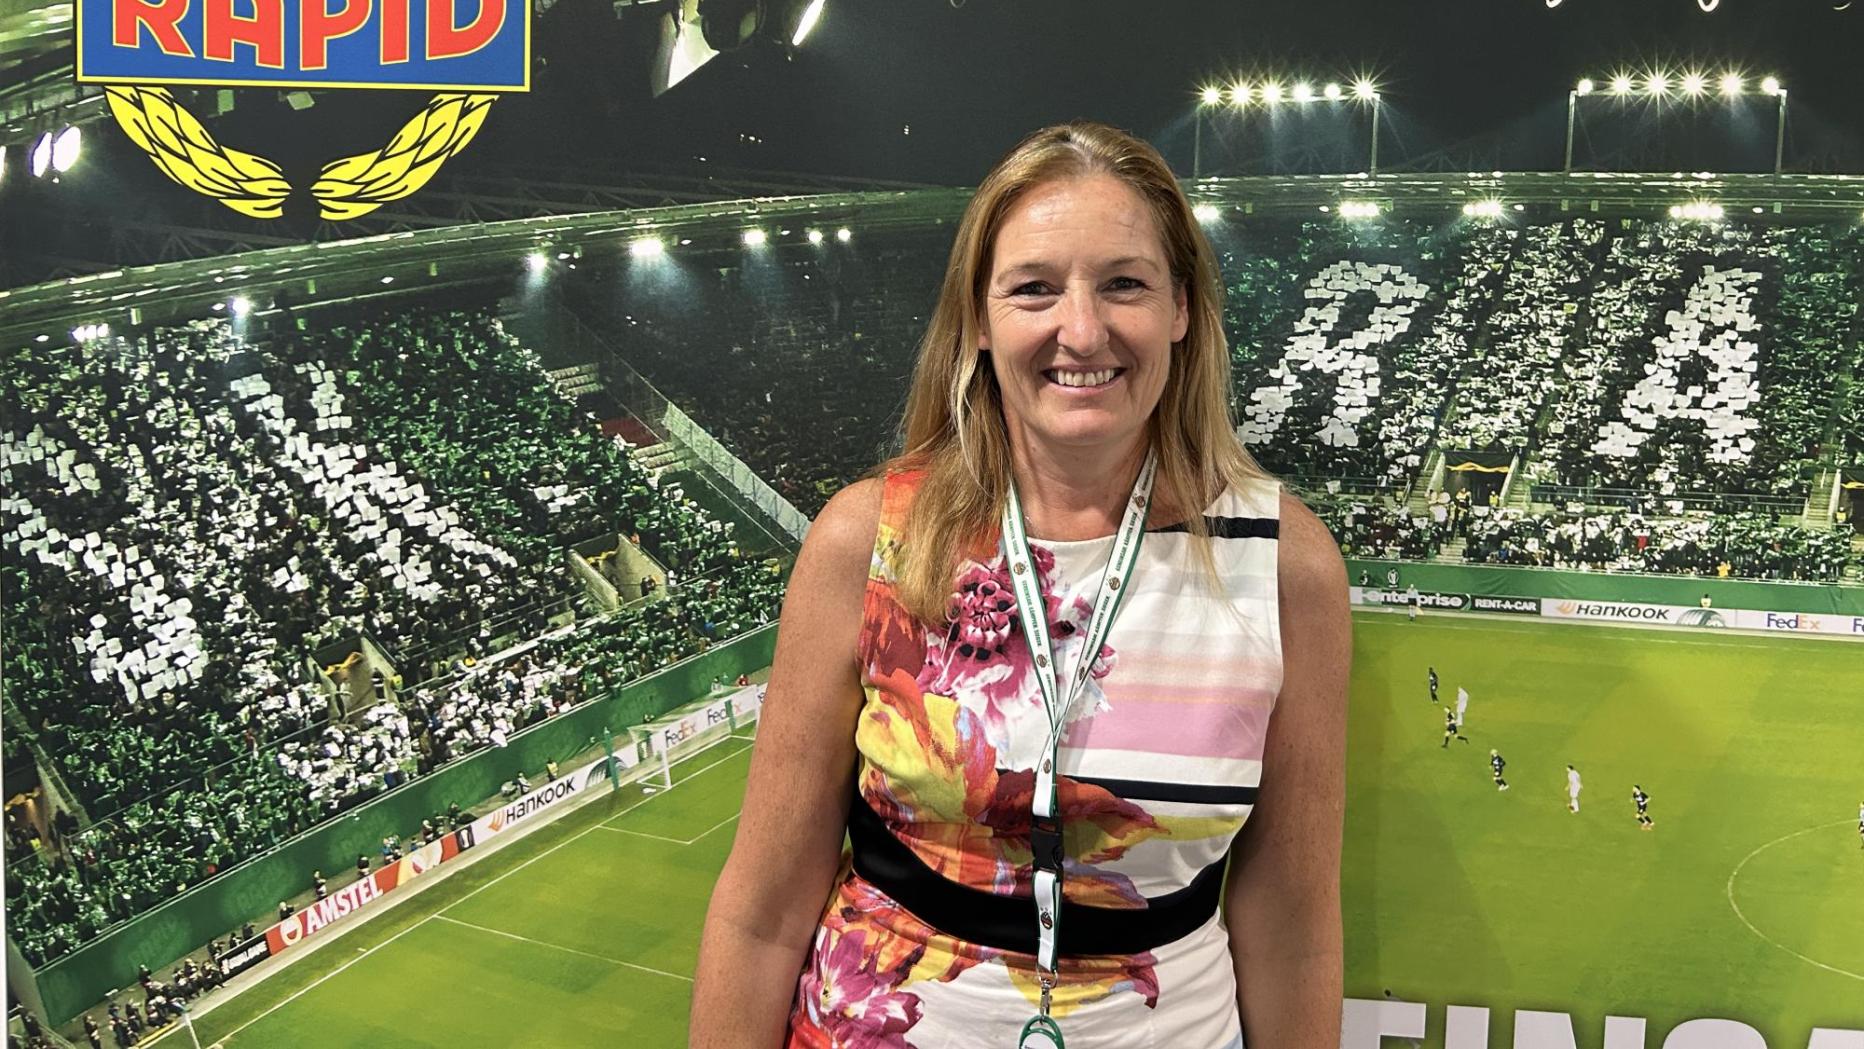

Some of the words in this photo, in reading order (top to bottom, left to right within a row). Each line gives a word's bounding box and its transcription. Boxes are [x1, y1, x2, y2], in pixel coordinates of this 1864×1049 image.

[112, 0, 507, 71] RAPID
[1365, 589, 1463, 608] enteprise
[1475, 599, 1537, 611] RENT-A-CAR
[1767, 613, 1821, 630] FedEx
[707, 702, 741, 726] Fedx
[665, 720, 697, 748] FedEx
[306, 873, 384, 935] AMSTEL
